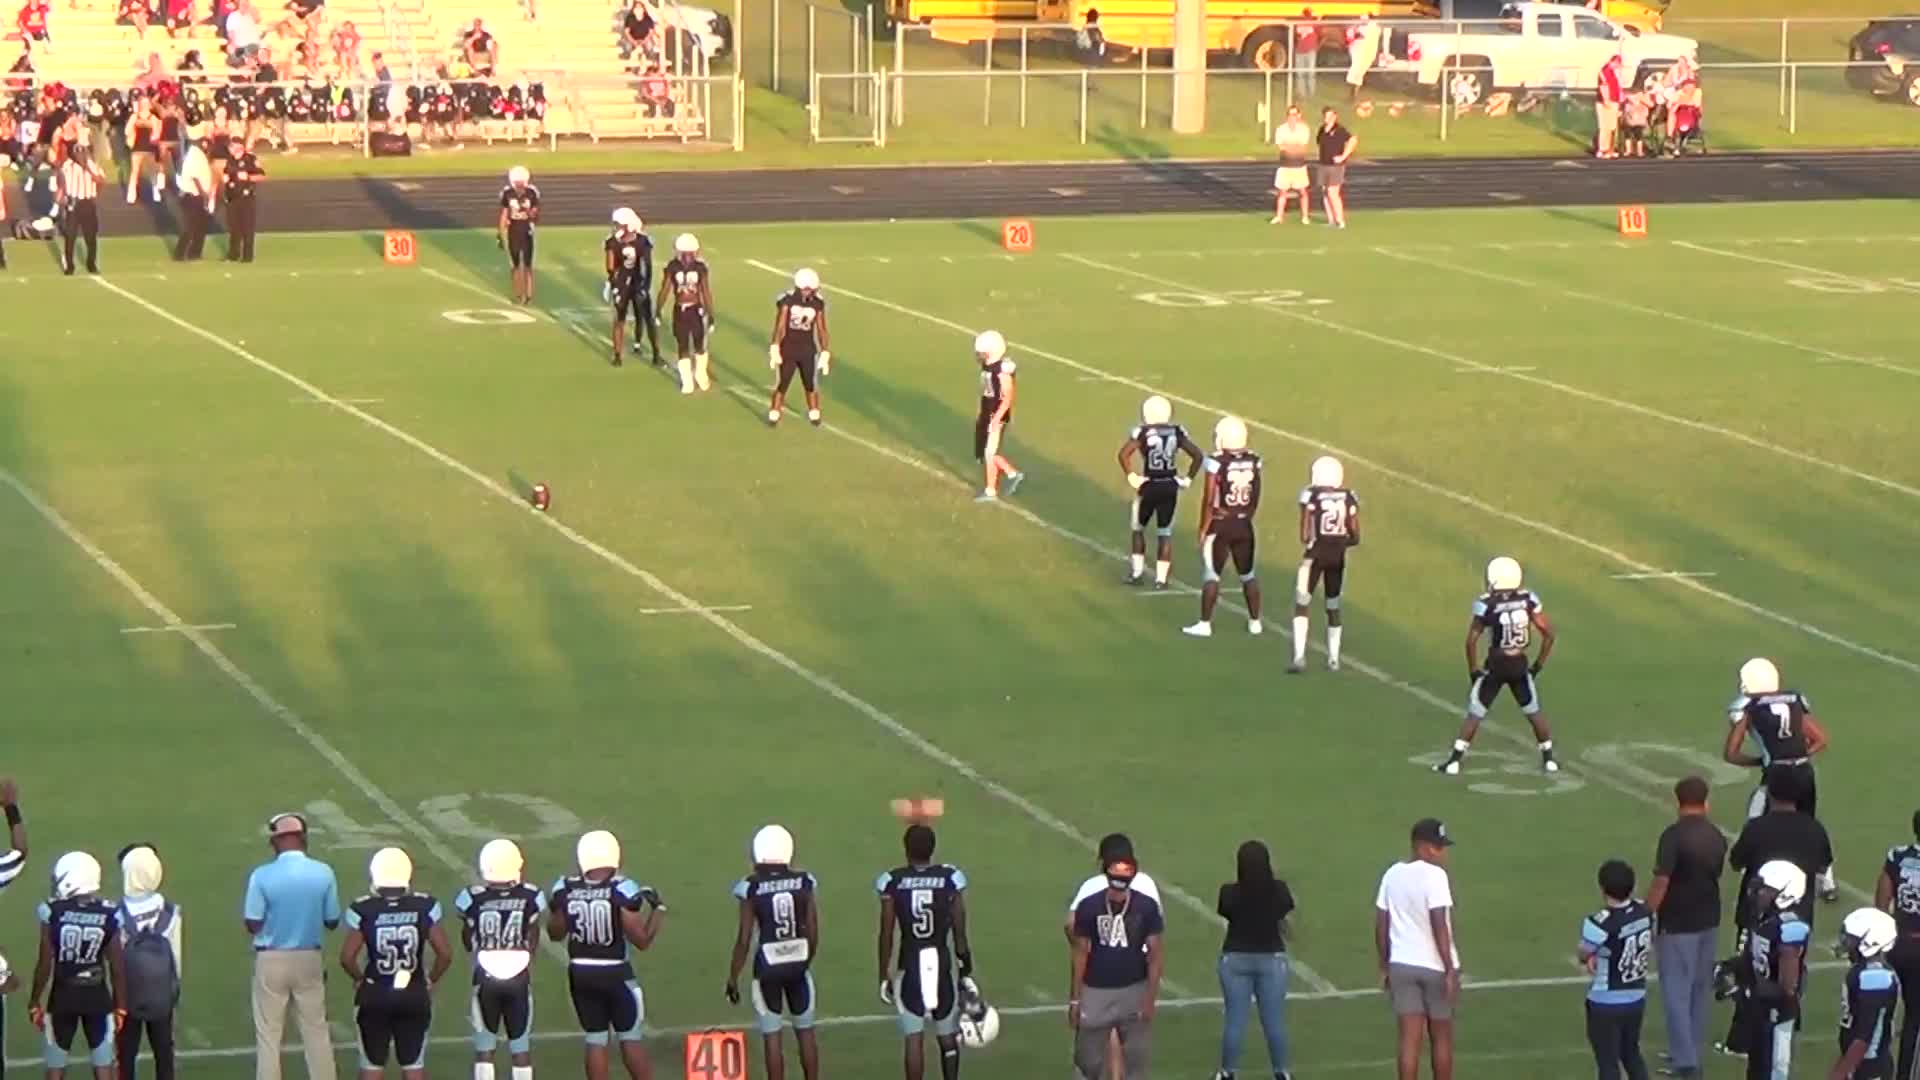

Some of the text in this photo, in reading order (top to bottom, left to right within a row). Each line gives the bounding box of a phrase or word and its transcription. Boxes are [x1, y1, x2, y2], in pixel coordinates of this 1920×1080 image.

[1009, 226, 1028, 245] 20
[1625, 211, 1642, 229] 10
[390, 237, 410, 256] 30
[1769, 703, 1792, 738] 7
[479, 911, 527, 951] 84
[567, 900, 614, 946] 30
[772, 892, 796, 940] 9
[912, 890, 934, 938] 5
[59, 925, 105, 964] 87
[376, 925, 419, 975] 53
[691, 1036, 742, 1080] 40
